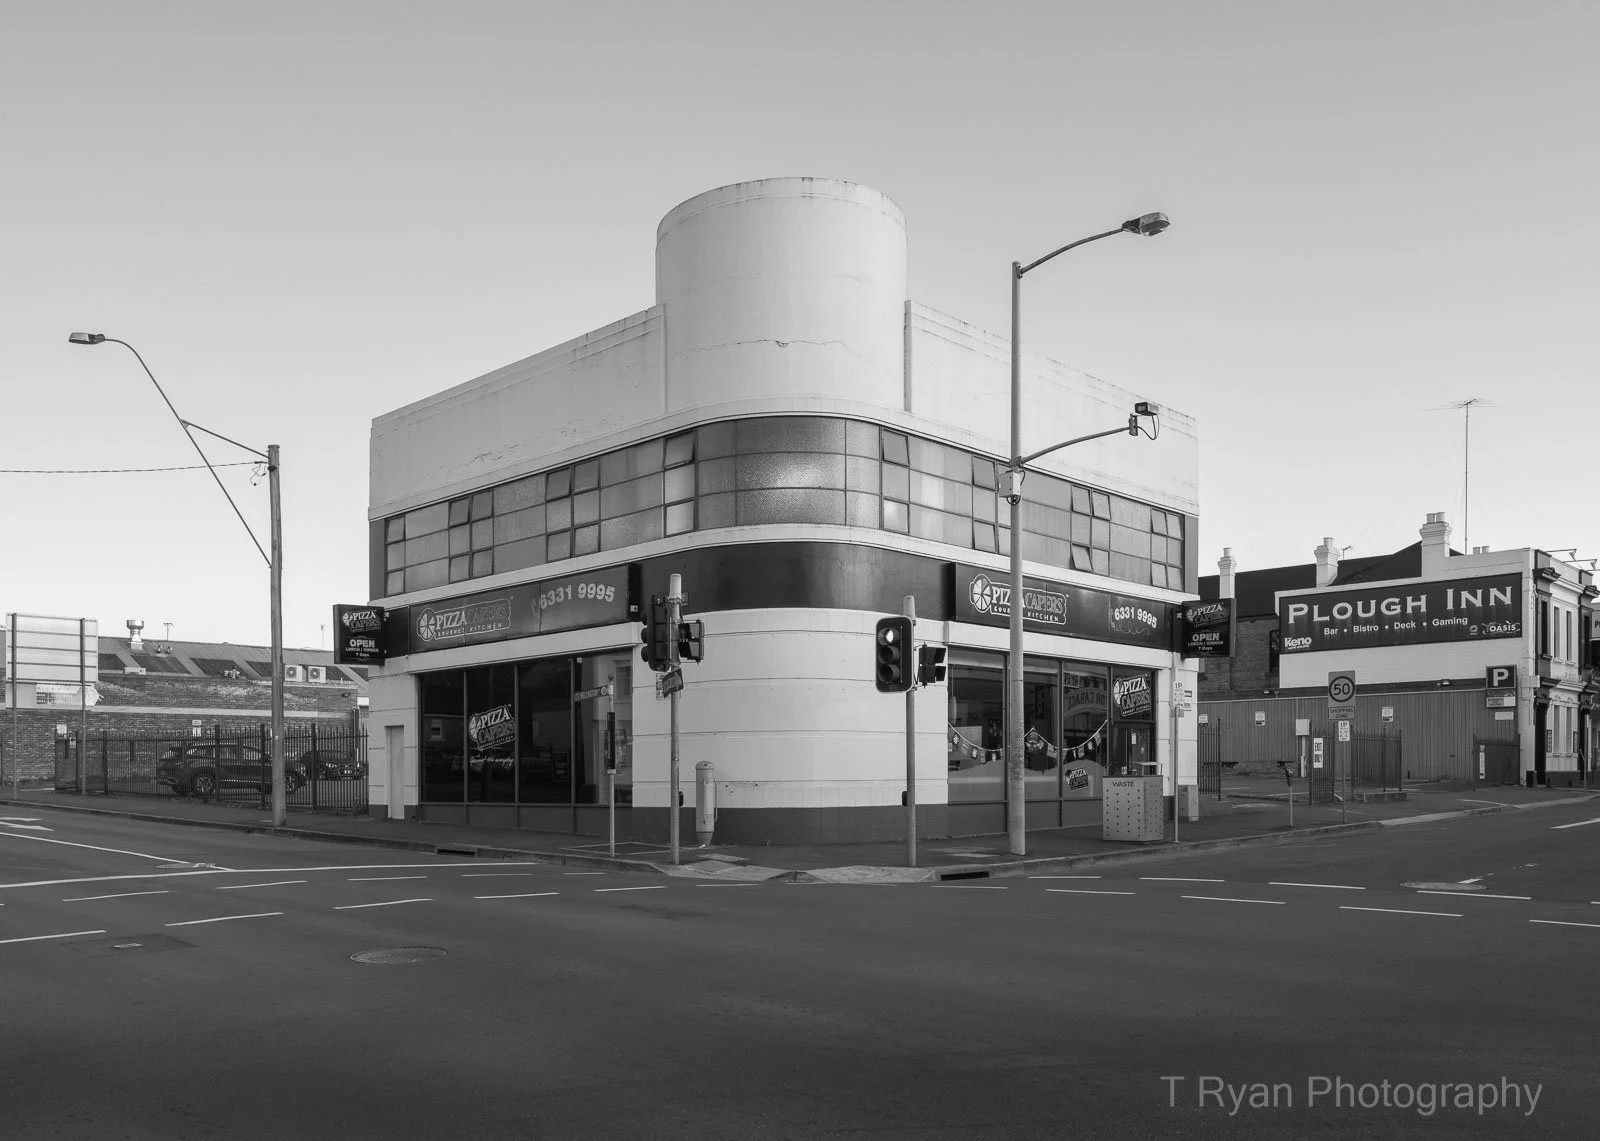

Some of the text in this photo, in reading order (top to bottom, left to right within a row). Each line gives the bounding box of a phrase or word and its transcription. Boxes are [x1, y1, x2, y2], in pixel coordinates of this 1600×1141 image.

[539, 583, 615, 609] 6331 9995
[1025, 592, 1064, 613] CAPERS
[1288, 586, 1512, 624] PLOUGH INN
[353, 611, 376, 620] PIZZA
[1028, 611, 1059, 622] KITCHEN
[1114, 606, 1157, 628] 6331 9995
[1197, 603, 1222, 616] PIZZA
[436, 610, 467, 630] PIZZA
[470, 622, 502, 632] KITCHEN
[1324, 616, 1468, 635] Bar Bistro Deck Gaming
[350, 639, 375, 648] OPEN
[1192, 633, 1220, 642] OPEN
[1124, 676, 1147, 694] PIZZA
[1493, 668, 1509, 686] P
[1334, 683, 1350, 695] 50
[1121, 689, 1151, 710] CAPERS
[481, 707, 511, 728] PIZZA
[1072, 768, 1087, 778] PIZZA
